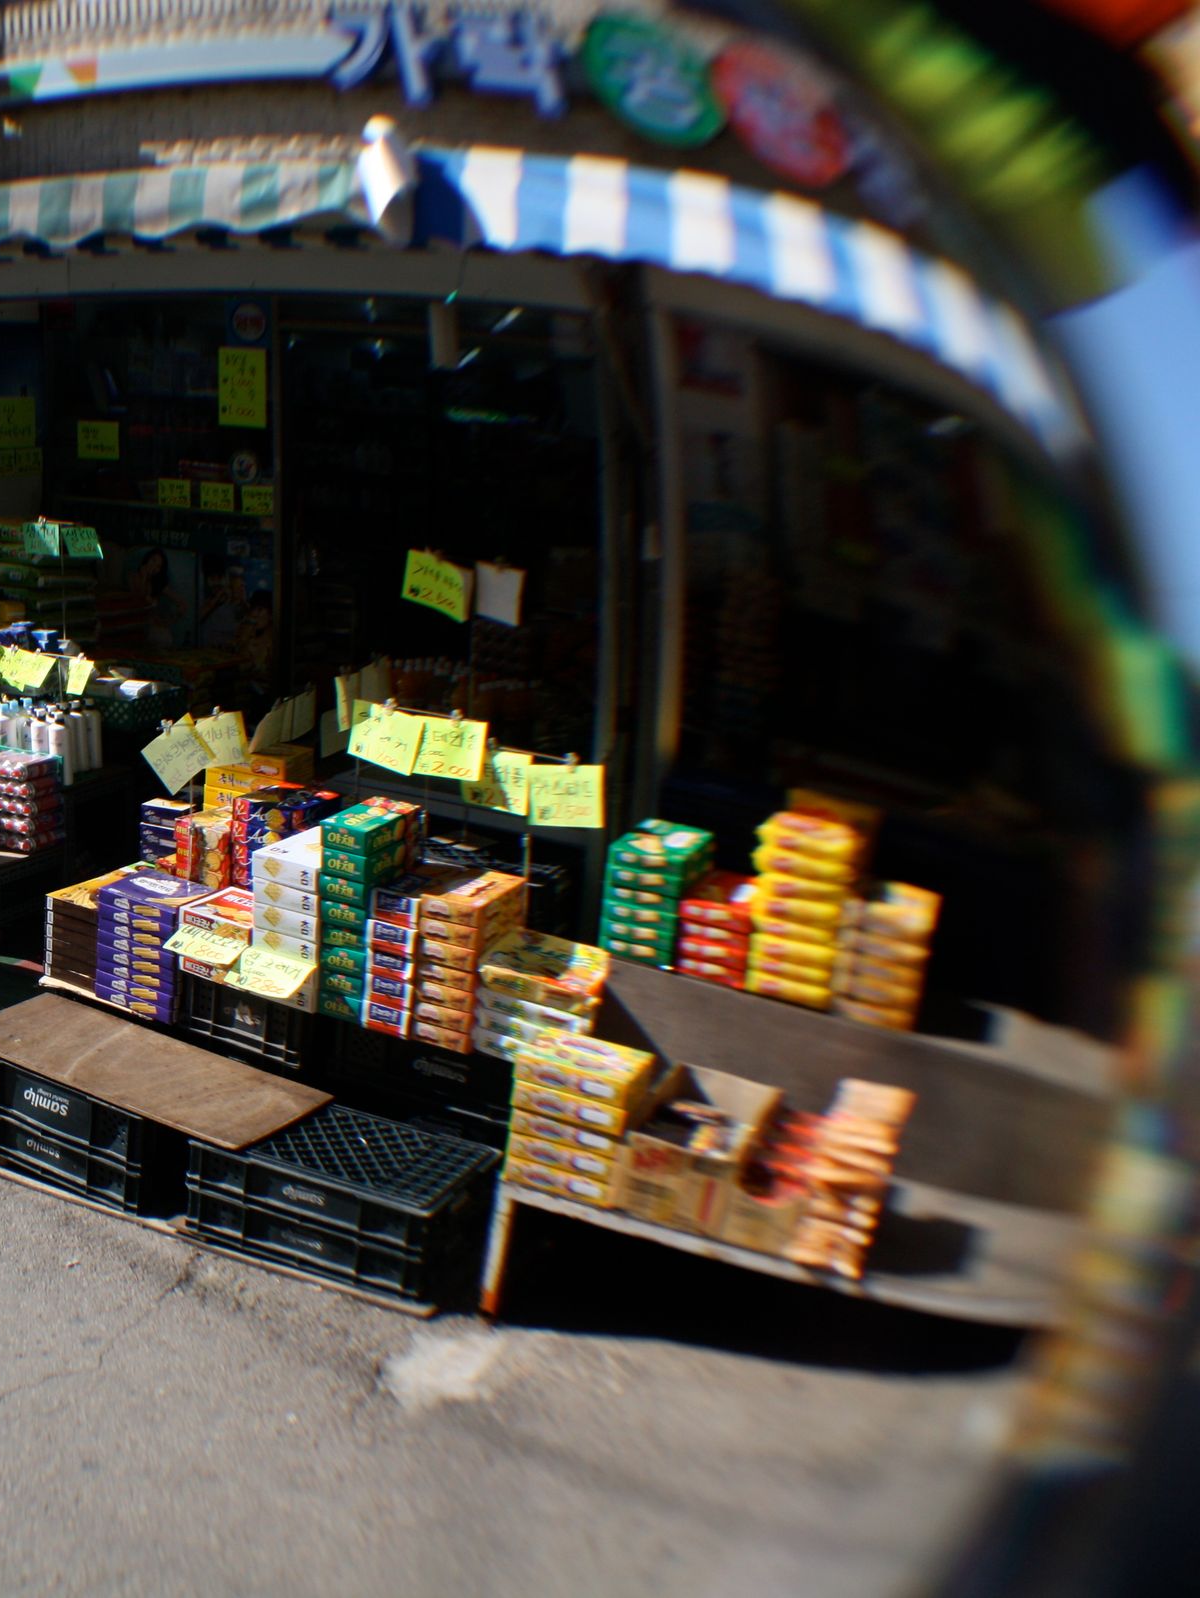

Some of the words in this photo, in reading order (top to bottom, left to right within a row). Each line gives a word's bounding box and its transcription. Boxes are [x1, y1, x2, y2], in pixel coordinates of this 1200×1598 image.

[327, 832, 355, 846] 야채
[327, 859, 355, 873] 야채
[326, 884, 354, 897] 야채
[328, 908, 356, 921] 야채
[327, 954, 354, 967] 야채
[23, 1087, 70, 1117] samlip
[26, 1139, 61, 1159] samlip
